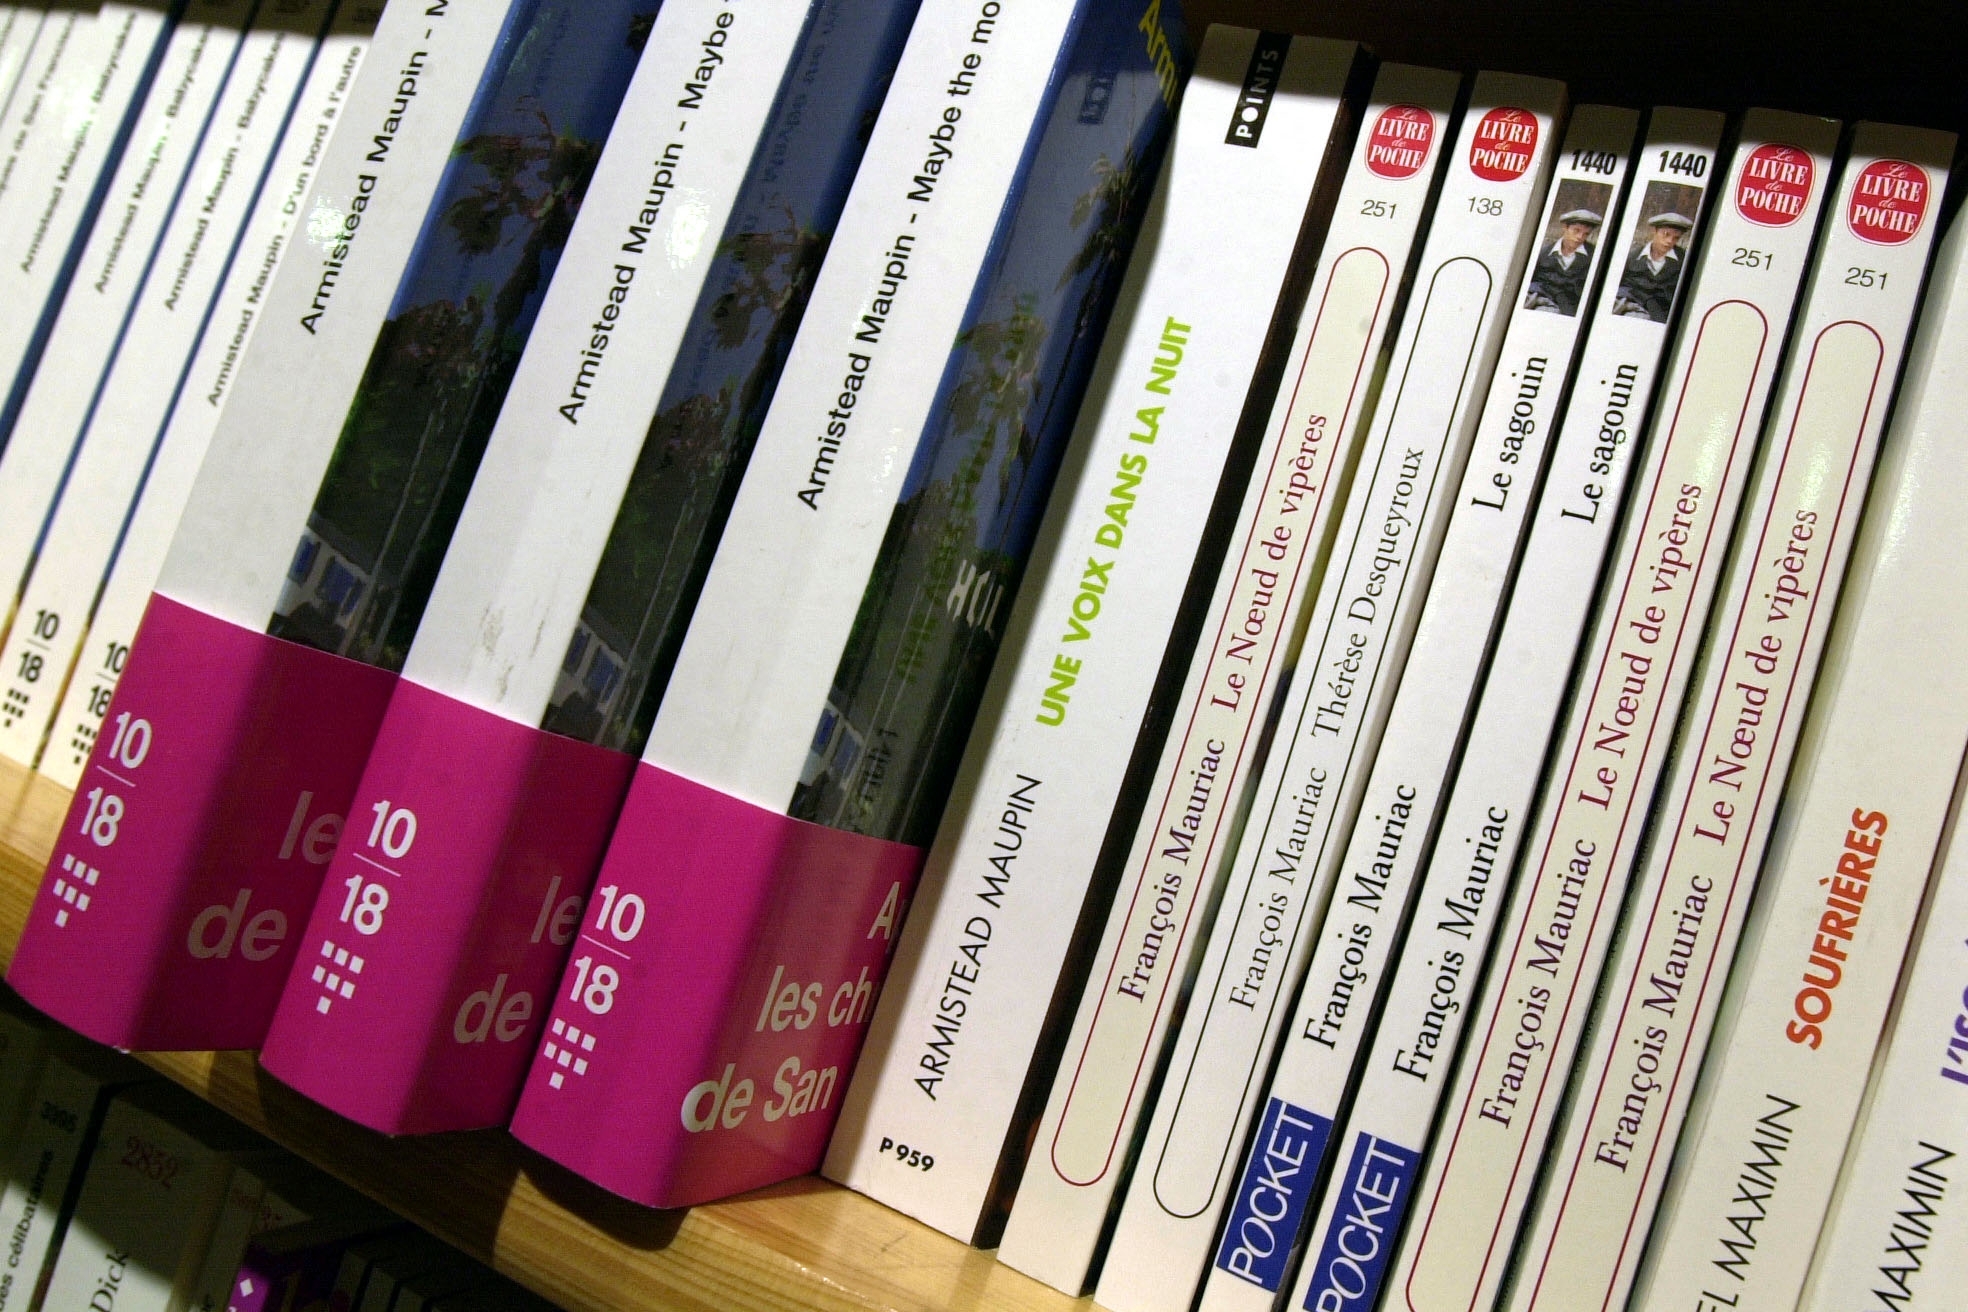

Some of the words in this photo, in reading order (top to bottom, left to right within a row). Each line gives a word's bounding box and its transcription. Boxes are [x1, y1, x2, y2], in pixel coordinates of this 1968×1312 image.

[1234, 49, 1280, 139] POINTS
[1368, 145, 1424, 169] POCHE
[1378, 118, 1431, 142] LIVRE
[1470, 147, 1528, 173] POCHE
[1481, 119, 1535, 145] LIVRE
[1569, 148, 1618, 176] 1440
[1658, 149, 1707, 178] 1440
[300, 175, 377, 336] Armistead
[366, 51, 429, 164] Maupin
[1467, 196, 1504, 217] 138
[1737, 186, 1803, 216] POCHE
[1748, 157, 1809, 186] LIVRE
[1860, 174, 1923, 203] LIVRE
[19, 186, 64, 274] Armistead
[164, 218, 209, 312] Armistead
[204, 146, 240, 214] Maupin
[207, 310, 254, 407] Armistead
[246, 237, 285, 305] Maupin
[284, 173, 310, 216] D'un
[301, 122, 329, 168] bord
[328, 44, 362, 102] l'autre
[559, 265, 636, 423] Armistead
[621, 140, 684, 254] Maupin
[678, 12, 734, 110] Maybe
[1360, 200, 1398, 219] 251
[1852, 203, 1919, 234] POCHE
[94, 204, 139, 294] Armistead
[797, 352, 872, 511] Armistead
[855, 234, 916, 345] Maupin
[908, 106, 962, 203] Maybe
[947, 53, 982, 97] the
[971, 1, 1001, 44] mo
[1731, 248, 1774, 271] 251
[1844, 266, 1890, 291] 251
[1145, 316, 1191, 395] NUIT
[1129, 405, 1166, 445] LA
[1279, 414, 1328, 515] vipères
[1095, 452, 1147, 552] DANS
[1260, 525, 1292, 562] de
[1649, 482, 1704, 595] vipères
[1763, 508, 1819, 624] vipères
[34, 609, 60, 640] 10
[1062, 557, 1114, 646] VOIX
[1225, 568, 1279, 666] Nœud
[1629, 605, 1667, 646] de
[18, 651, 44, 683] 18
[104, 641, 129, 673] 10
[1744, 634, 1784, 676] de
[88, 684, 113, 718] 18
[1036, 655, 1083, 727] UNE
[1210, 671, 1246, 713] Le
[1303, 922, 1373, 1051] François
[1346, 784, 1417, 914] Mauriac
[1471, 472, 1512, 512] Le
[1498, 356, 1549, 464] sagouin
[1392, 950, 1465, 1083] François
[1437, 806, 1509, 941] Mauriac
[1560, 482, 1604, 525] Le
[1589, 363, 1640, 476] sagouin
[1593, 652, 1654, 759] Nœud
[109, 711, 152, 769] 10
[1228, 890, 1289, 1012] François
[1268, 766, 1328, 884] Mauriac
[1310, 633, 1367, 737] Thérèse
[1347, 447, 1424, 626] Desqueyroux
[1708, 682, 1770, 793] Nœud
[82, 786, 125, 846] 18
[1160, 738, 1225, 866] Mauriac
[1578, 766, 1619, 812] Le
[1692, 801, 1736, 847] Le
[365, 799, 417, 859] 10
[976, 773, 1043, 908] MAUPIN
[187, 888, 287, 961] de
[338, 874, 389, 936] 18
[530, 875, 585, 946] le
[595, 884, 645, 942] 10
[1117, 872, 1182, 1004] François
[1525, 839, 1597, 980] Mauriac
[1641, 875, 1715, 1020] Mauriac
[453, 974, 534, 1045] de
[568, 955, 619, 1015] 18
[755, 965, 823, 1032] les
[914, 915, 993, 1101] ARMISTEAD
[1478, 986, 1552, 1130] François
[1711, 1094, 1802, 1281] MAXIMIN
[1785, 808, 1889, 1052] SOUFRIÈRES
[680, 1063, 755, 1133] de
[763, 1056, 838, 1122] San
[1593, 1025, 1669, 1175] François
[880, 1136, 894, 1154] P
[895, 1142, 935, 1173] 959
[1227, 1102, 1314, 1285] POCKET
[1315, 1136, 1406, 1312] POCKET
[88, 1248, 131, 1312] Dick
